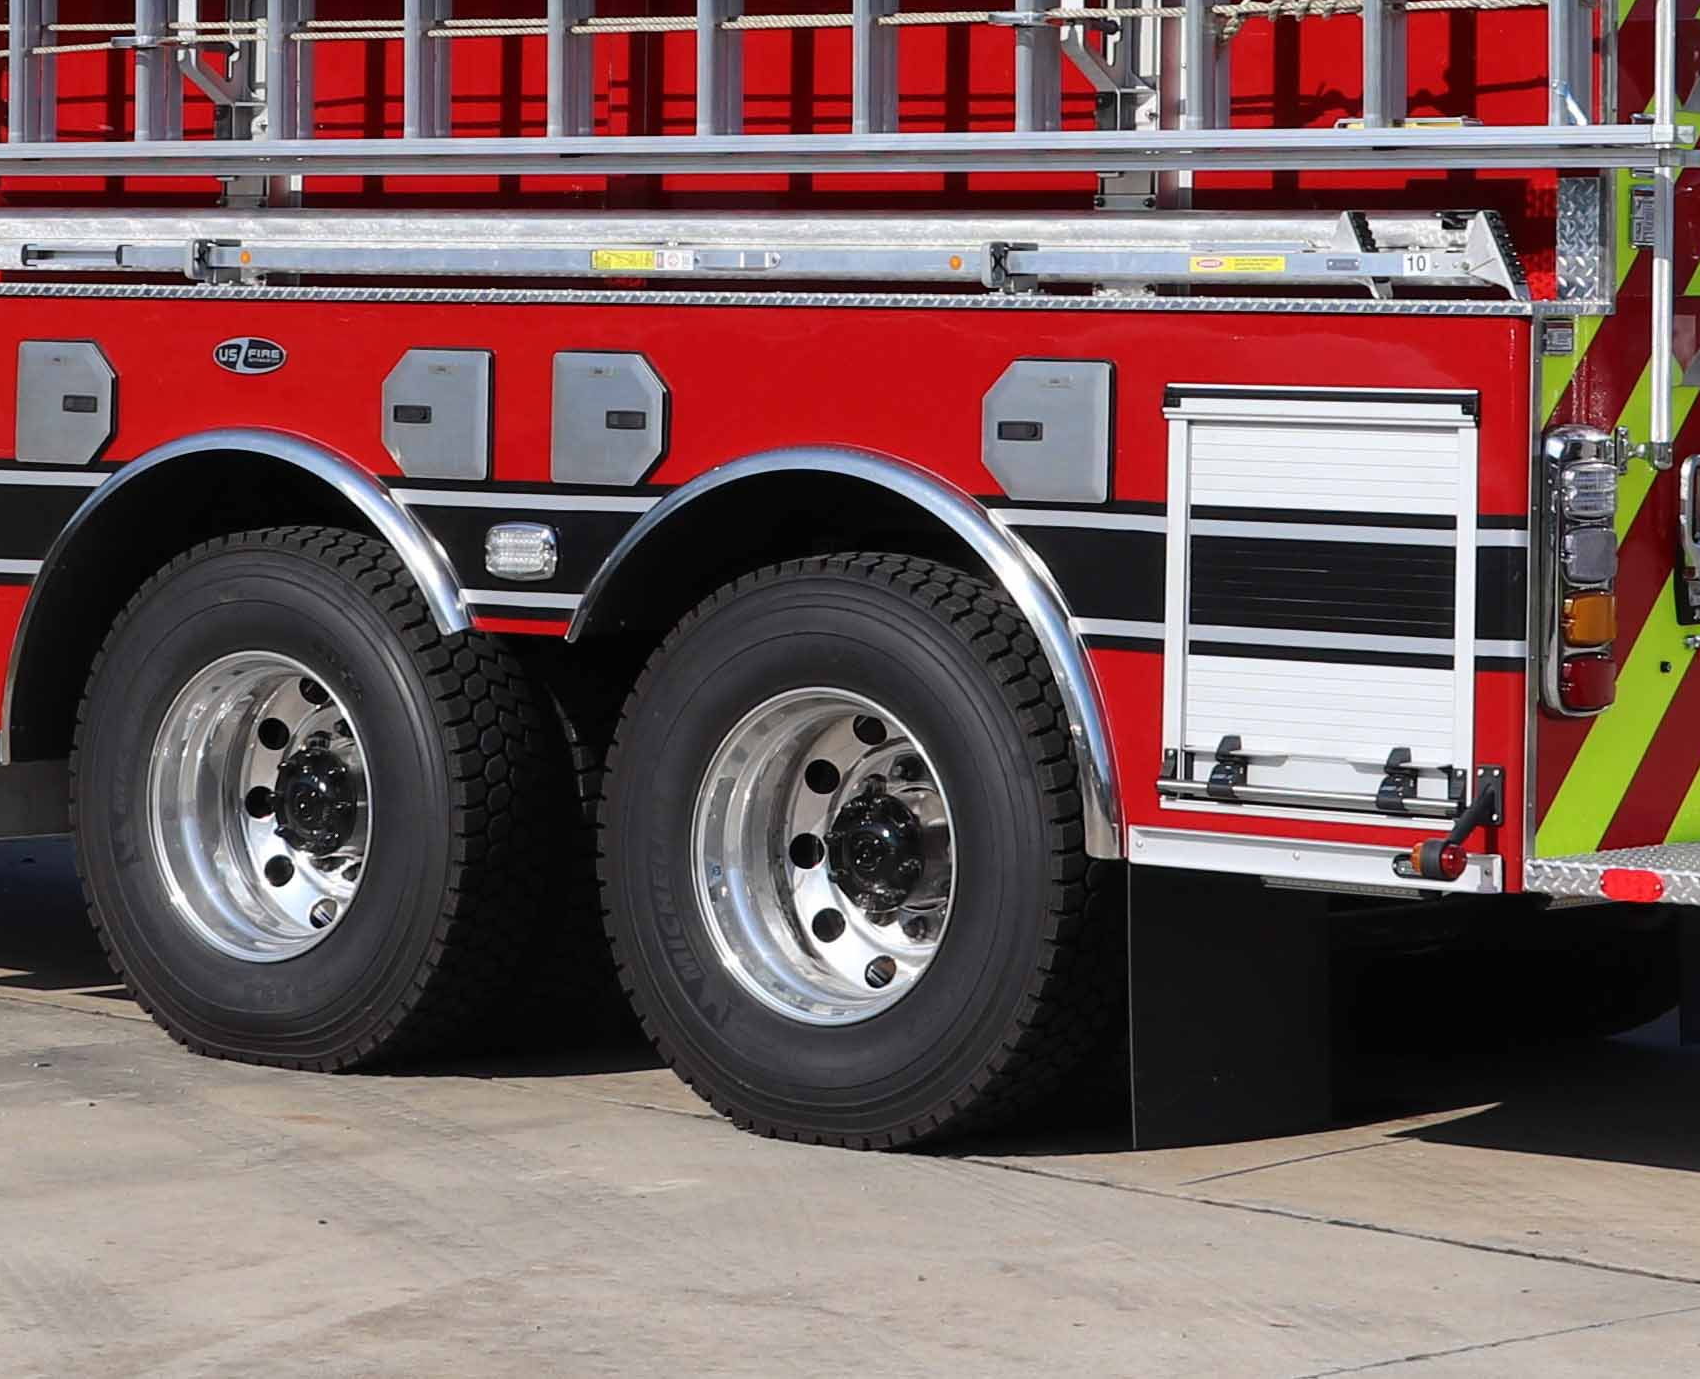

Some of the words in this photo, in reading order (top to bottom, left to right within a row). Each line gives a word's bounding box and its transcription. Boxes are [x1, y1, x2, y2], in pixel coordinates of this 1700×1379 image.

[1407, 256, 1426, 272] 10
[219, 349, 238, 361] US
[248, 349, 280, 358] FIRE
